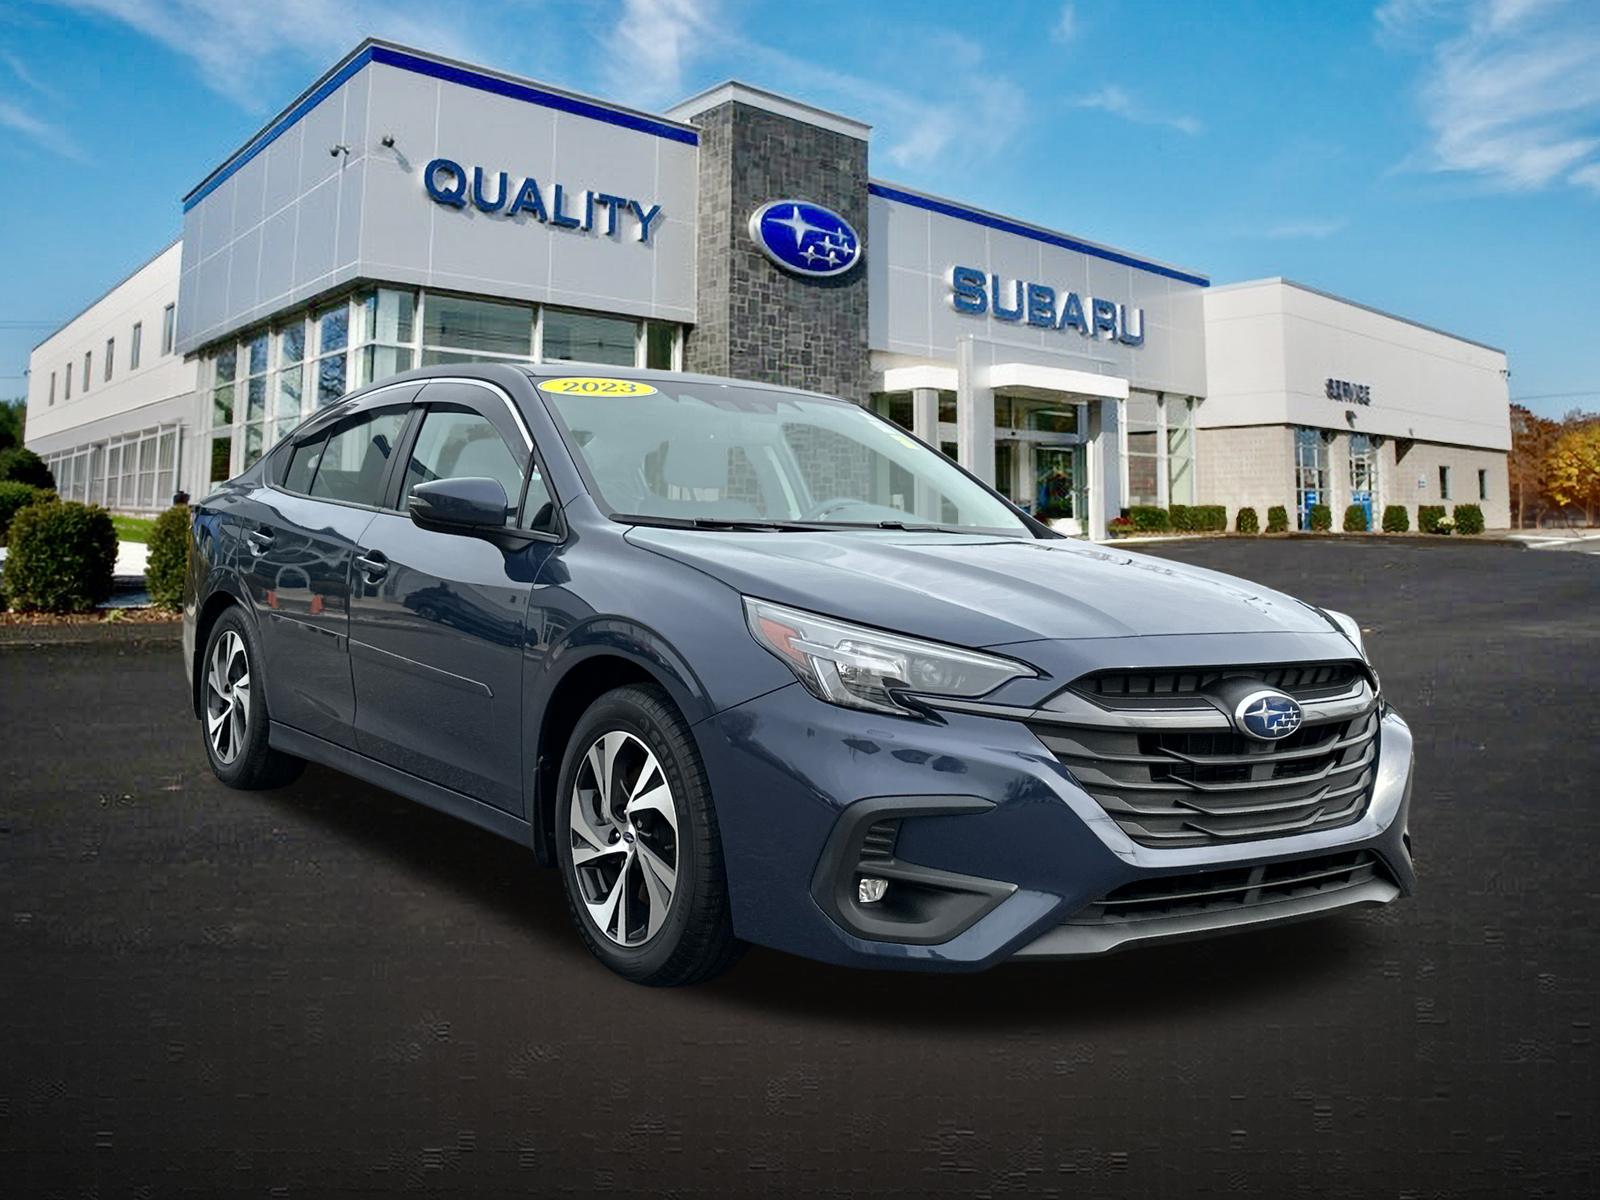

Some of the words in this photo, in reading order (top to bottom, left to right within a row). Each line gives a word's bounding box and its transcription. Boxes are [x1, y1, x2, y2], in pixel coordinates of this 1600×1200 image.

[424, 158, 662, 242] QUALITY
[949, 266, 1144, 347] SUBARU
[563, 381, 637, 394] 2023
[1325, 377, 1371, 407] SERVICE
